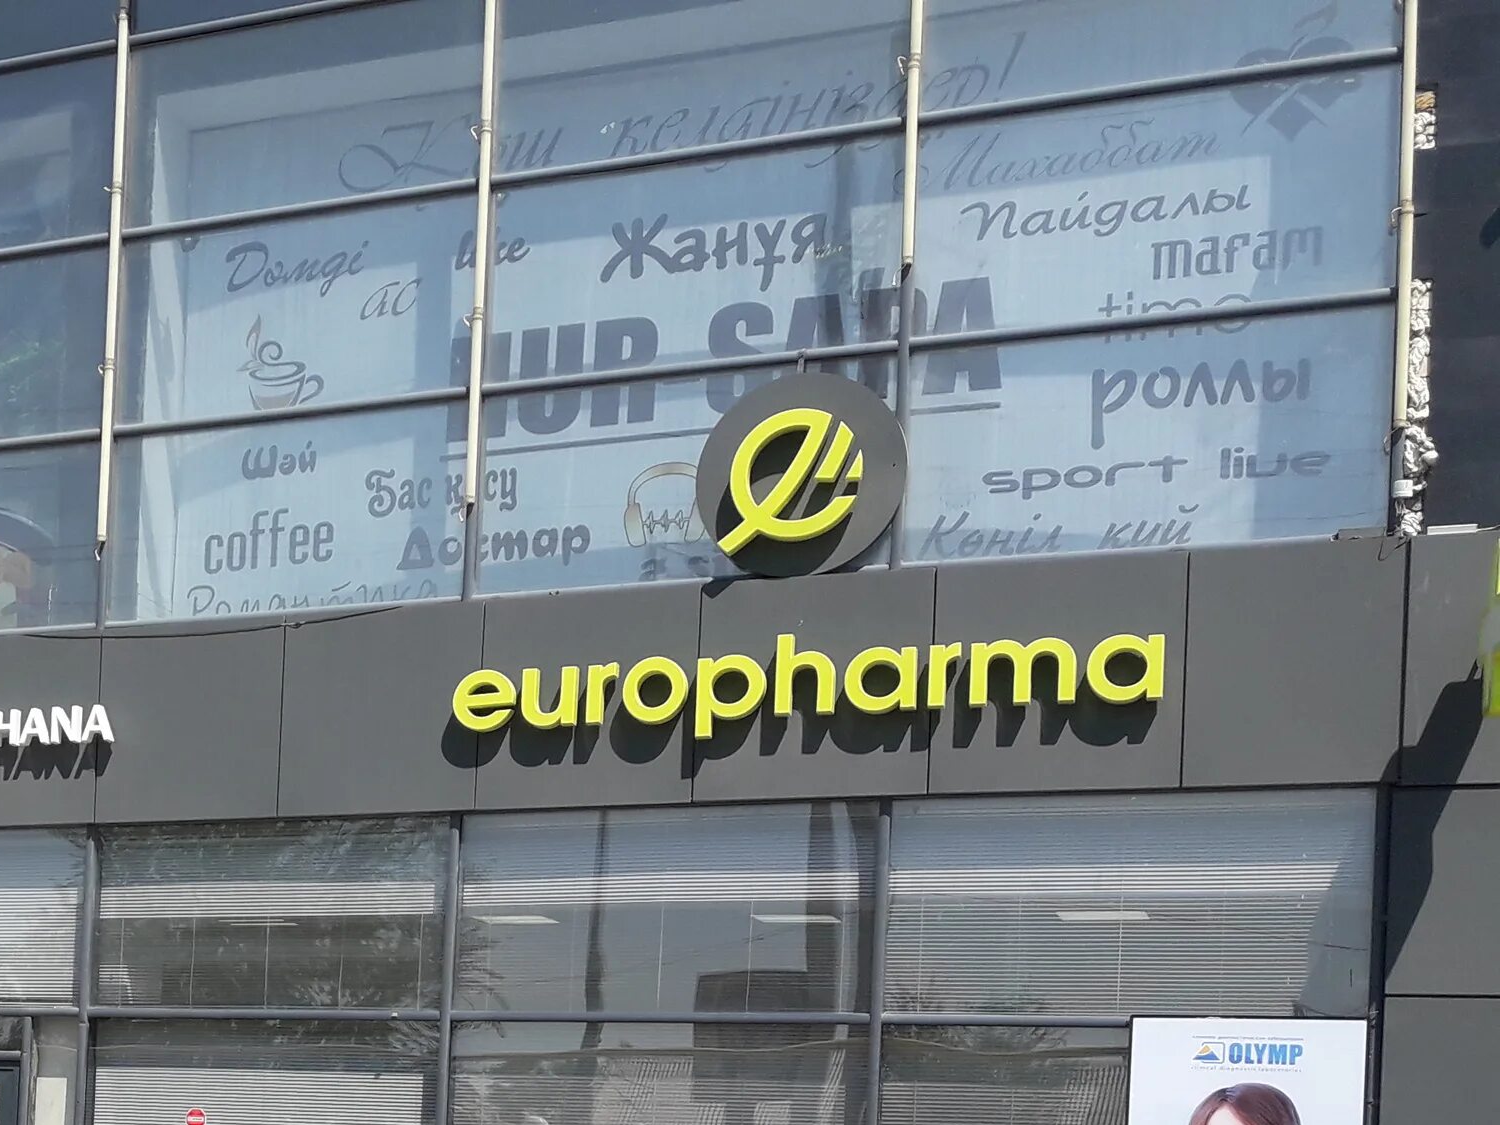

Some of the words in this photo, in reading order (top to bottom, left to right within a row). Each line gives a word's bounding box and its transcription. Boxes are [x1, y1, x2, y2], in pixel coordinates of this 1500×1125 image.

[961, 184, 1251, 241] Пайдалы
[1091, 356, 1312, 450] роллы
[365, 467, 432, 518] Бас
[445, 467, 518, 515] қсу
[982, 455, 1188, 501] sport
[204, 508, 334, 575] coffee
[452, 633, 1166, 740] europharma
[1228, 1042, 1303, 1065] OLYMP
